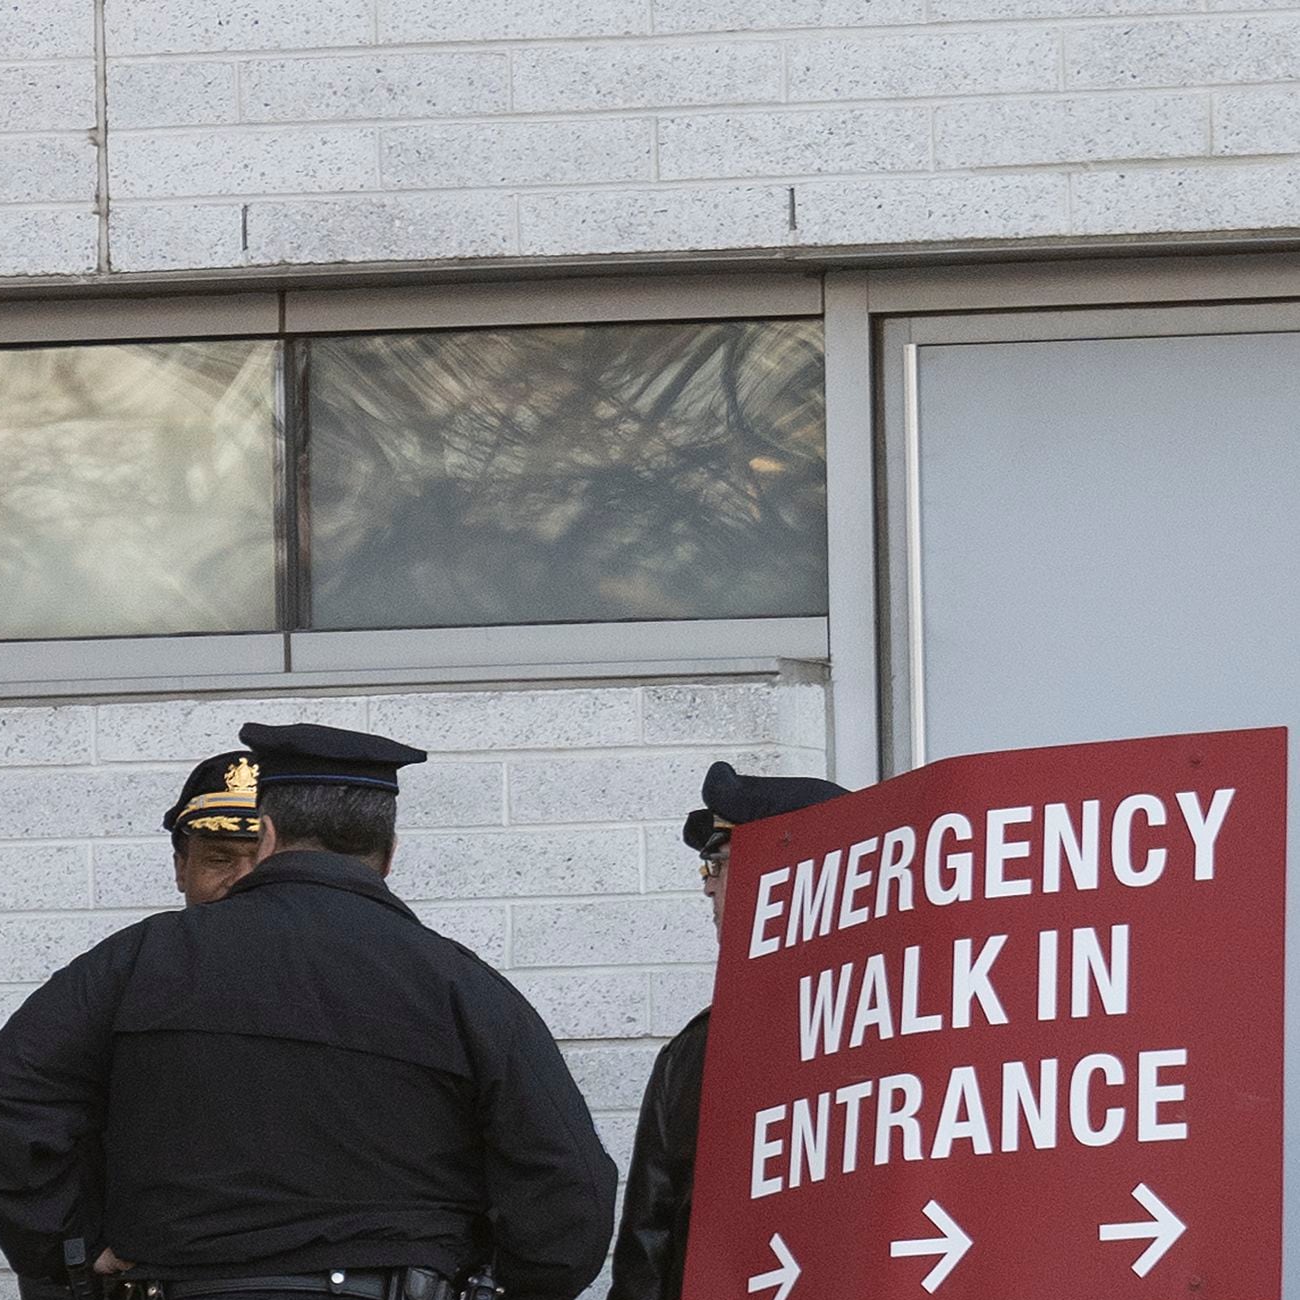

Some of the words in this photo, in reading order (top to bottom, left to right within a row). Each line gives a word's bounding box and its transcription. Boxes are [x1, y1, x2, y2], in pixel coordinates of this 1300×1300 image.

[748, 788, 1236, 960] EMERGENCY
[799, 933, 1009, 1062] WALK
[1037, 924, 1130, 1022] IN
[750, 1047, 1189, 1200] ENTRANCE
